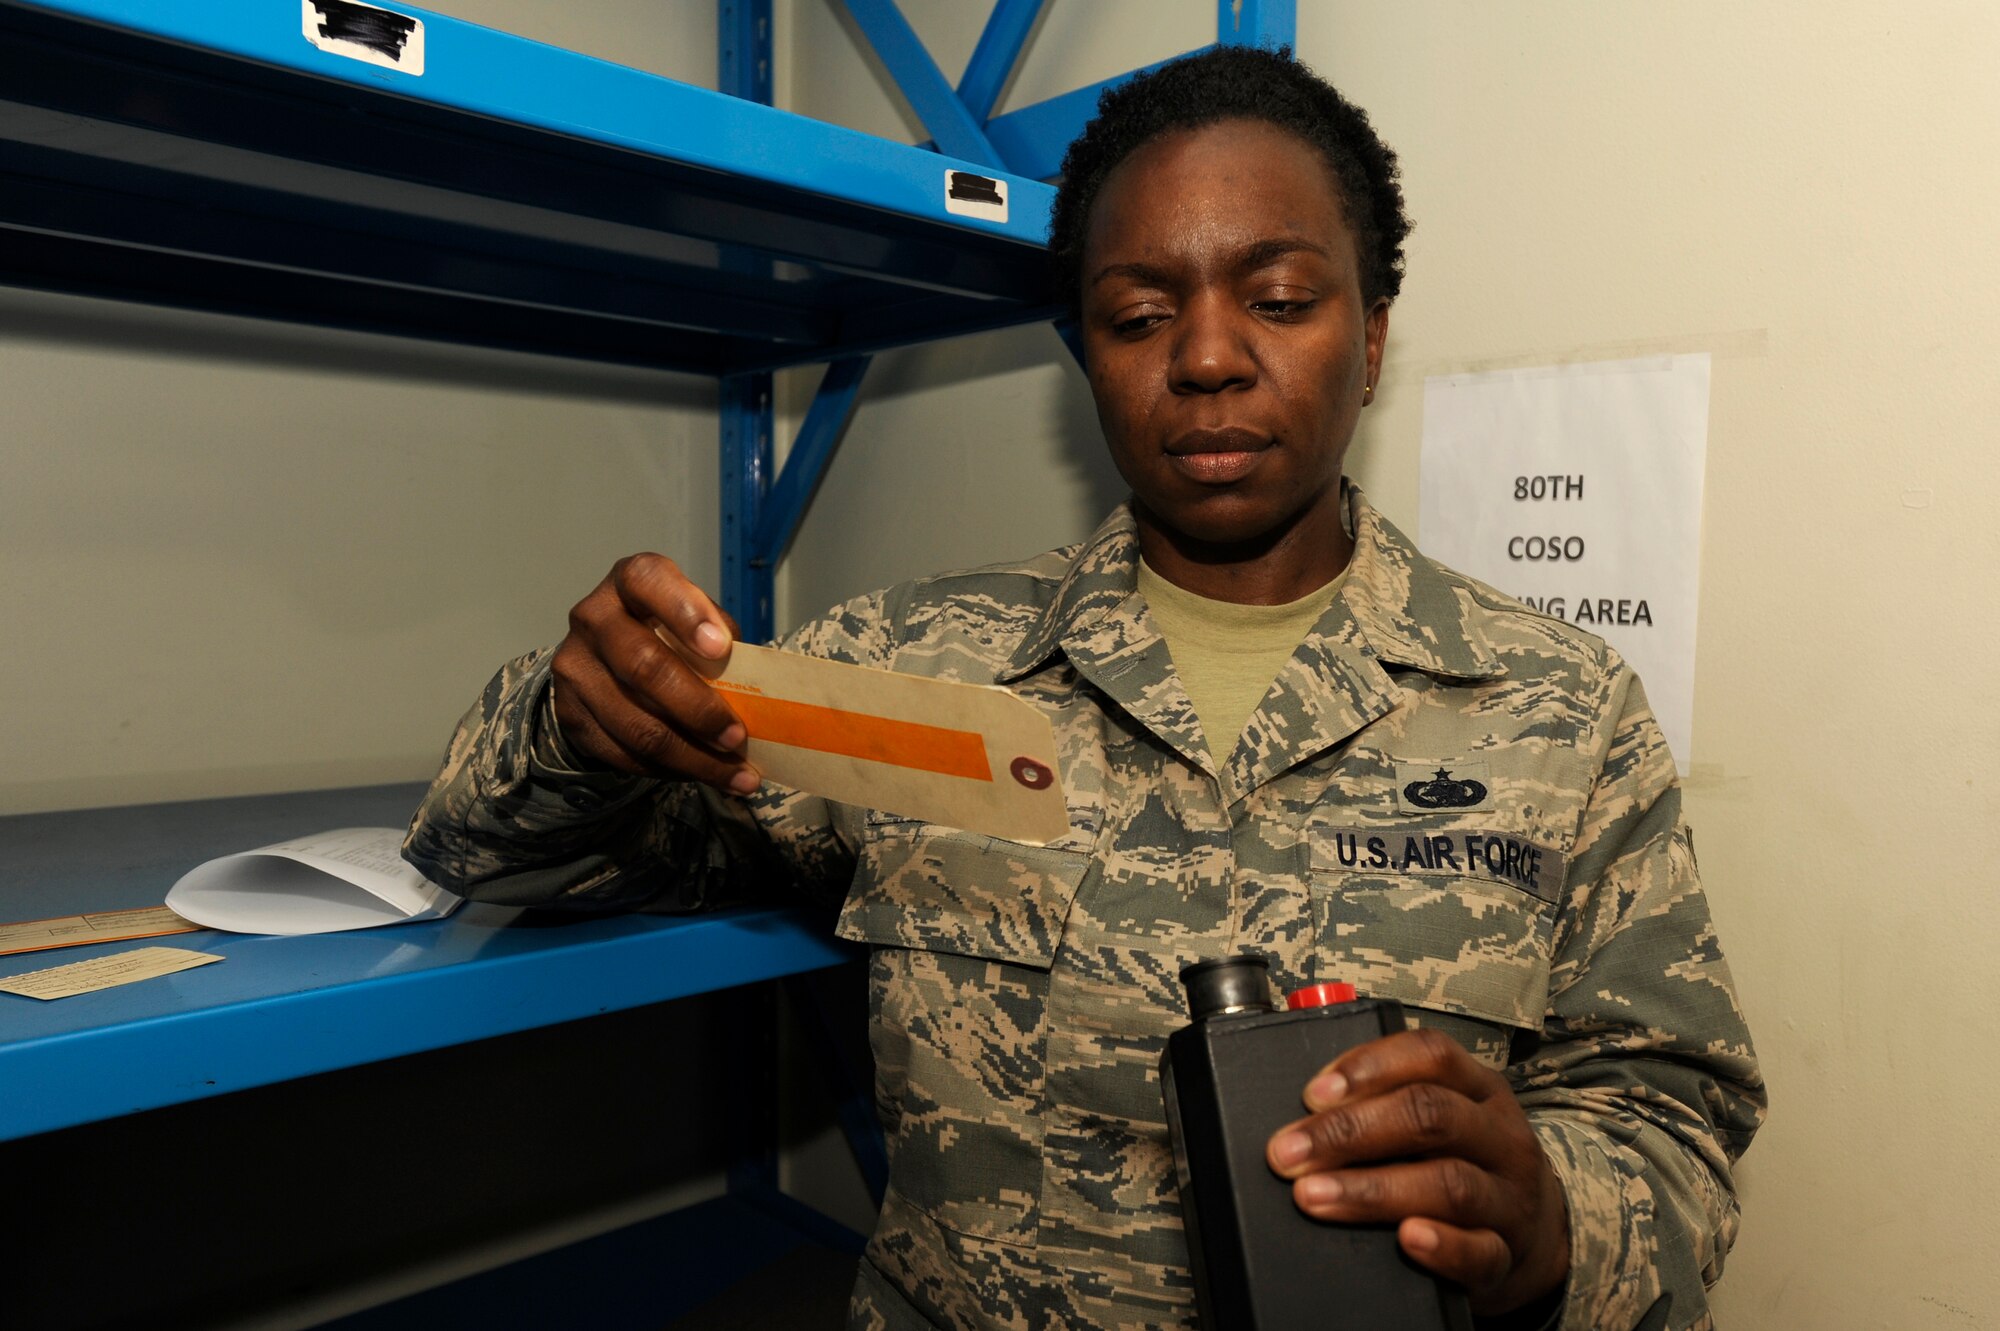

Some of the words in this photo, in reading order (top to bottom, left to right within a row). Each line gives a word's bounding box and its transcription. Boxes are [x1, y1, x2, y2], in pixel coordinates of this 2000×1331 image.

[1513, 475, 1585, 501] 80TH
[1508, 536, 1585, 561] COSO
[1517, 596, 1566, 620] NG
[1574, 598, 1653, 626] AREA
[1335, 832, 1398, 870] U.S.
[1402, 835, 1462, 872] AIR
[1465, 835, 1542, 889] FORCE
